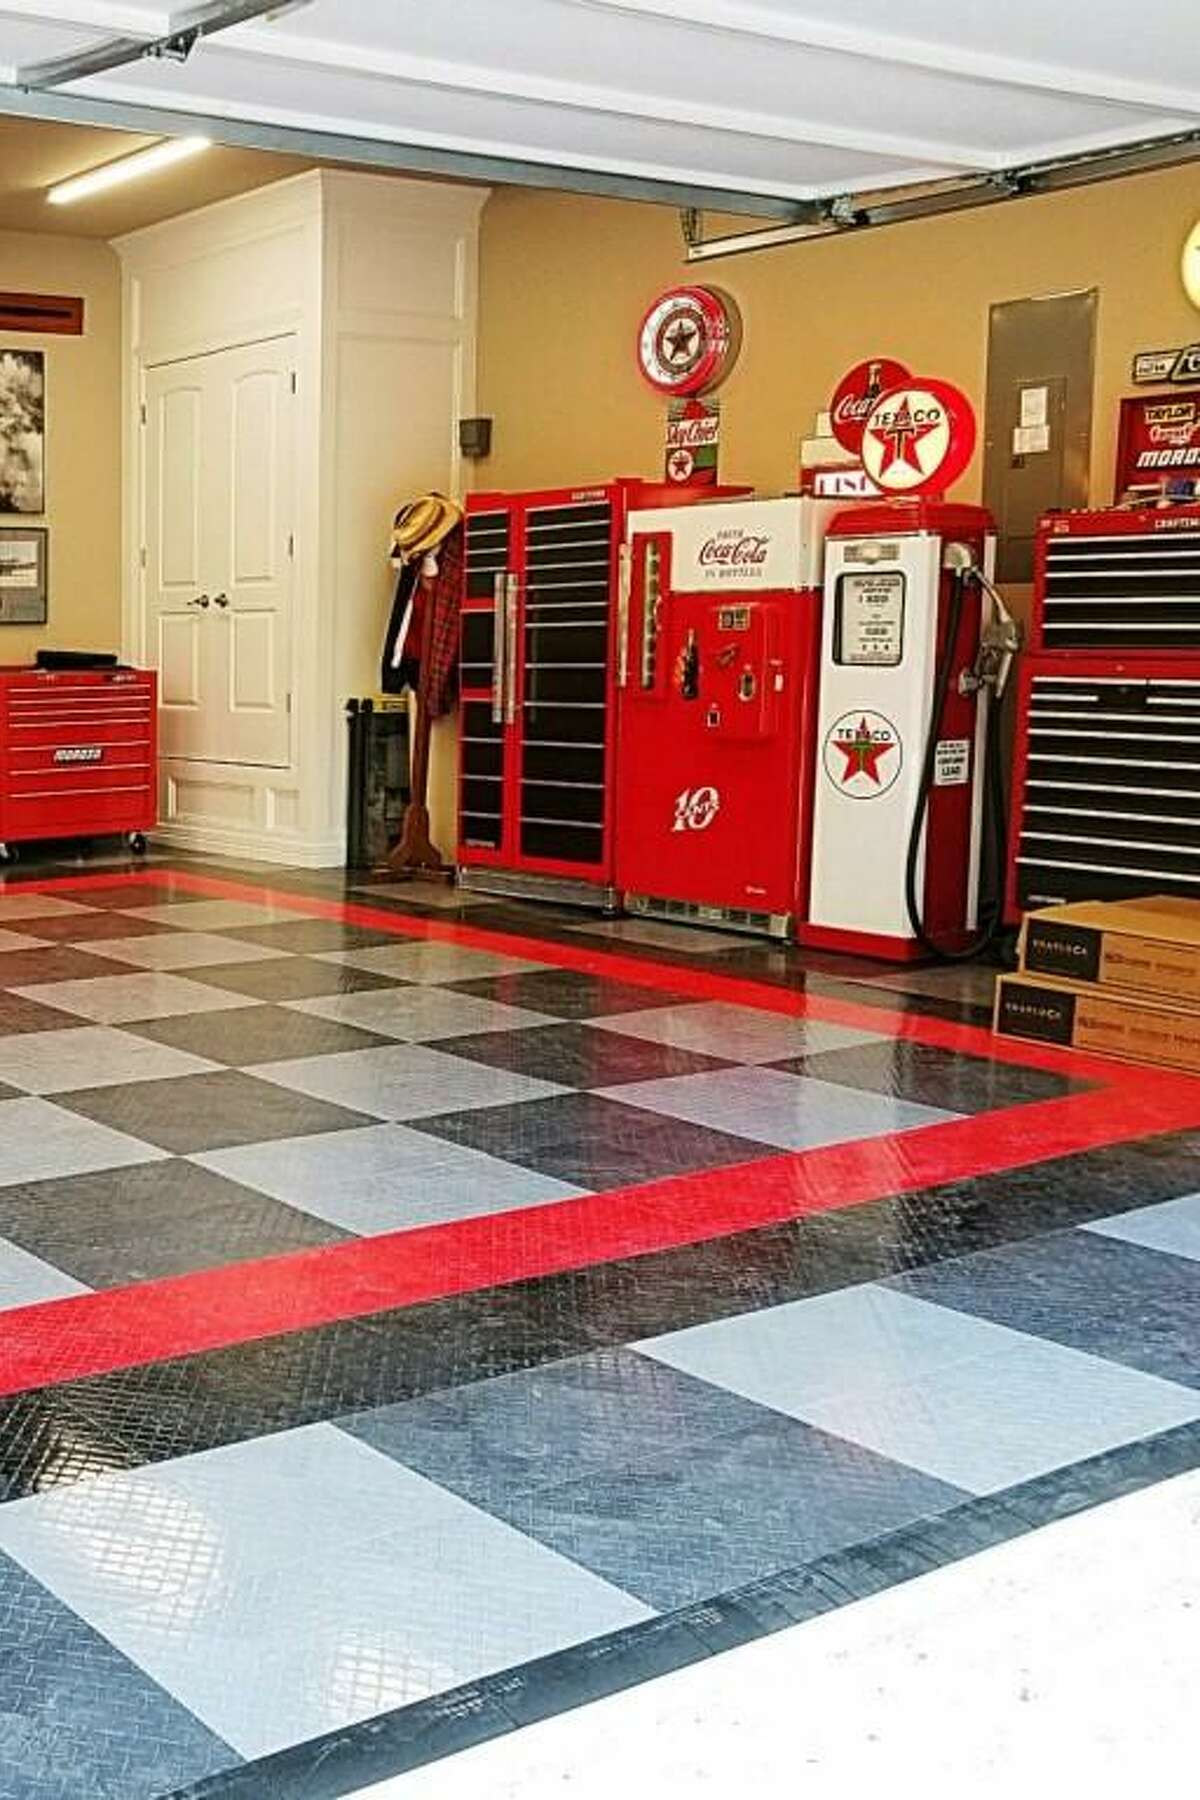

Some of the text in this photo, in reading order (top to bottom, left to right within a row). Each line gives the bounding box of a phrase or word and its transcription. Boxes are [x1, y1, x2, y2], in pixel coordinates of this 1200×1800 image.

[874, 409, 941, 425] TEXACO
[1136, 448, 1200, 467] MORO
[837, 728, 891, 741] TEXACO
[671, 787, 719, 832] 10
